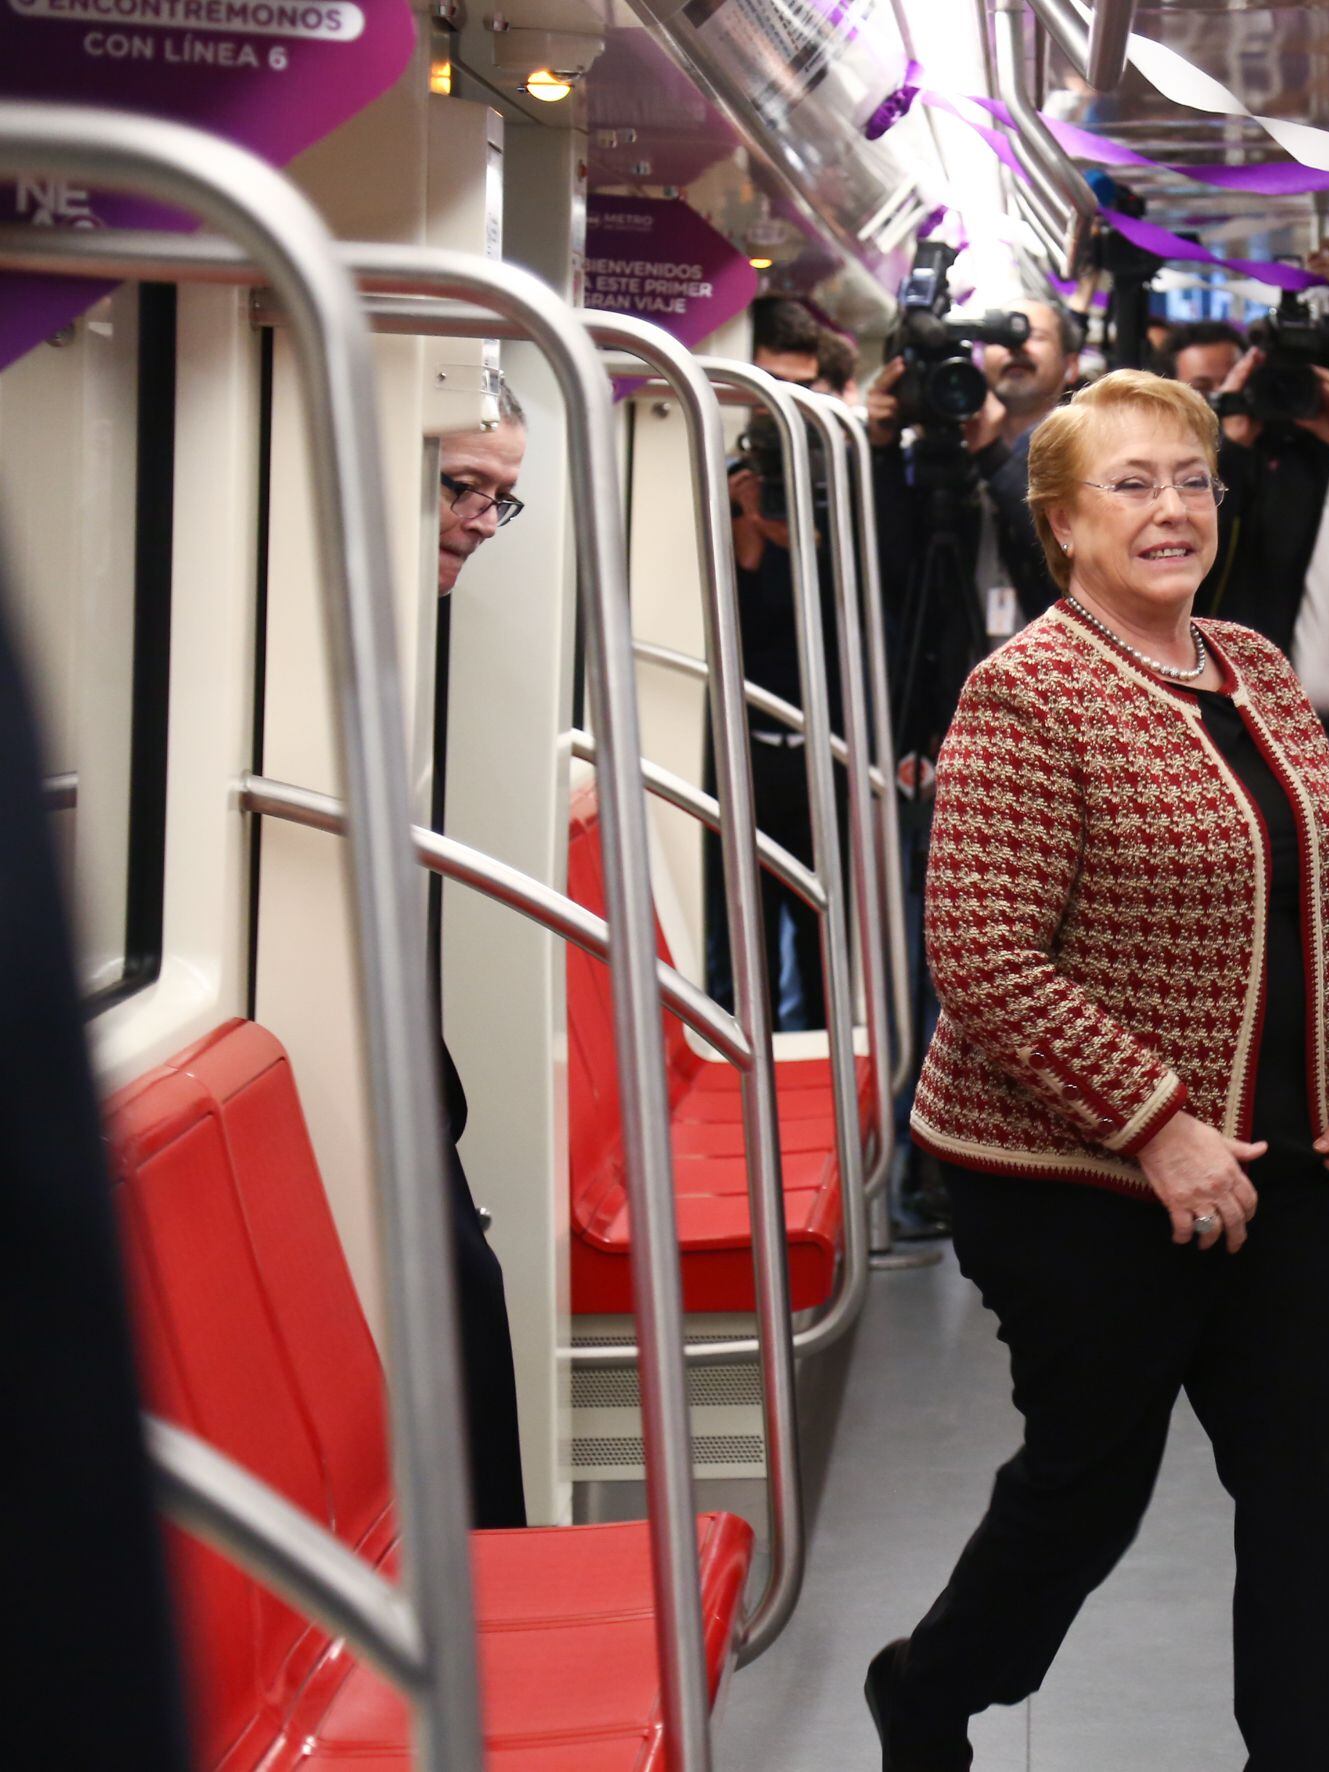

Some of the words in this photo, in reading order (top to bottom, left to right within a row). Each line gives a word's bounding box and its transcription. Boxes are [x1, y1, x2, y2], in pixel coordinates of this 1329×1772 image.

[83, 31, 154, 59] CON
[165, 33, 259, 67] LÍNEA
[268, 46, 288, 70] 6
[596, 275, 639, 294] ESTE
[643, 279, 713, 298] PRIMER
[633, 295, 687, 314] VIAJE
